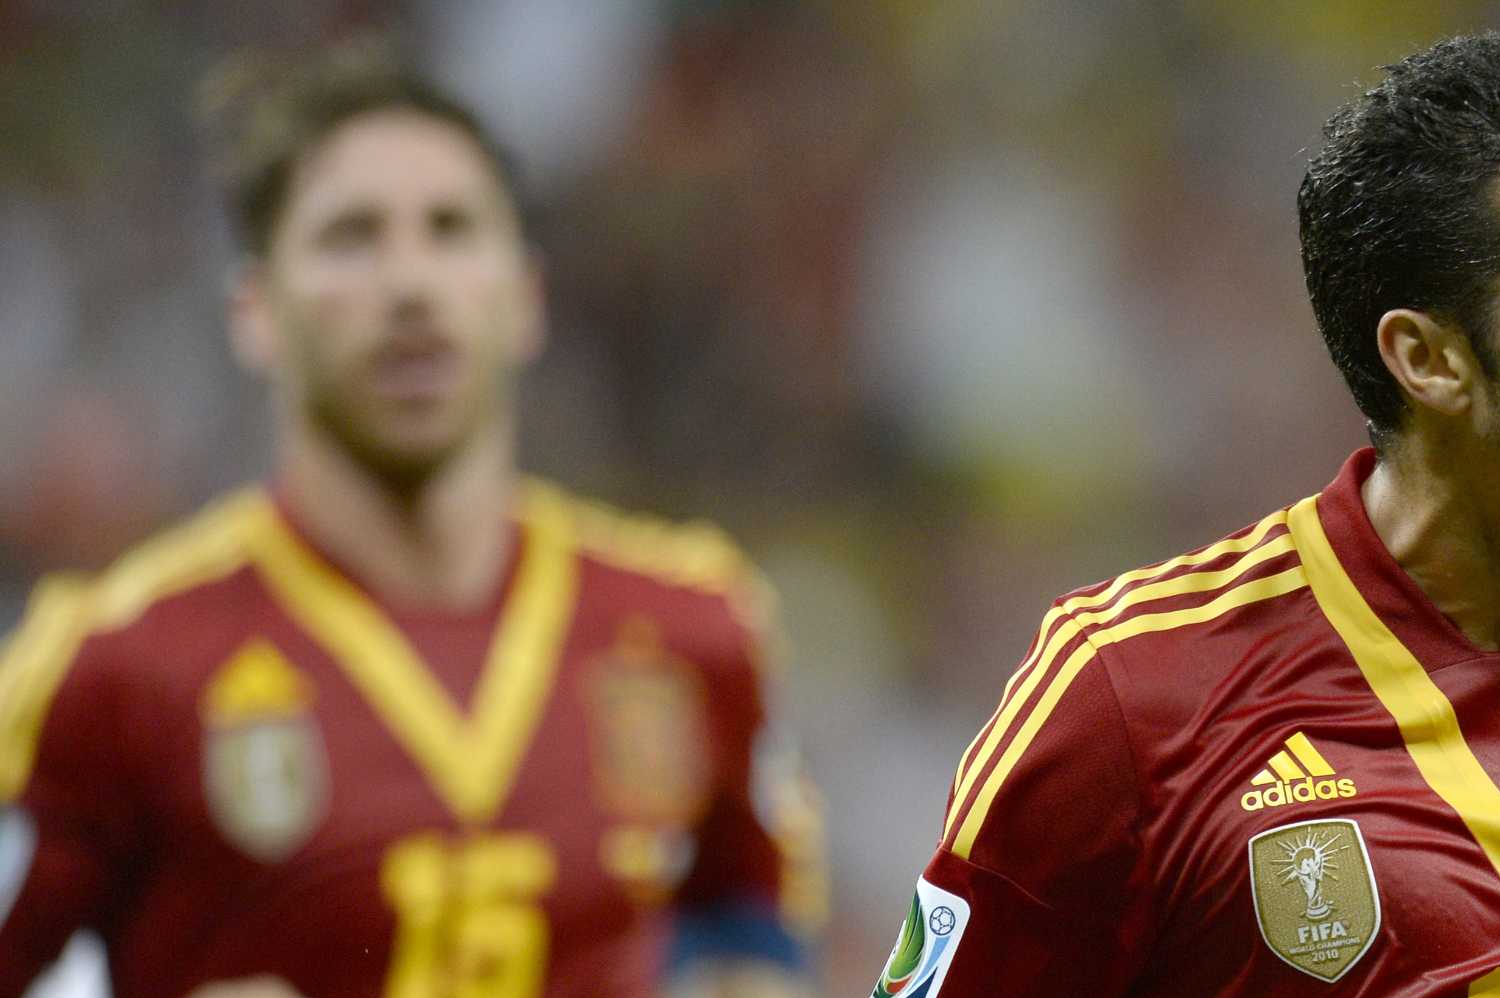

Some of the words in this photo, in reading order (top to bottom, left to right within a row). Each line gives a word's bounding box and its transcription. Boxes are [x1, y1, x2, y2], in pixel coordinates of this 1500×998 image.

[1241, 776, 1357, 811] adidas
[1298, 921, 1347, 944] FIFA
[1311, 949, 1339, 962] 2010
